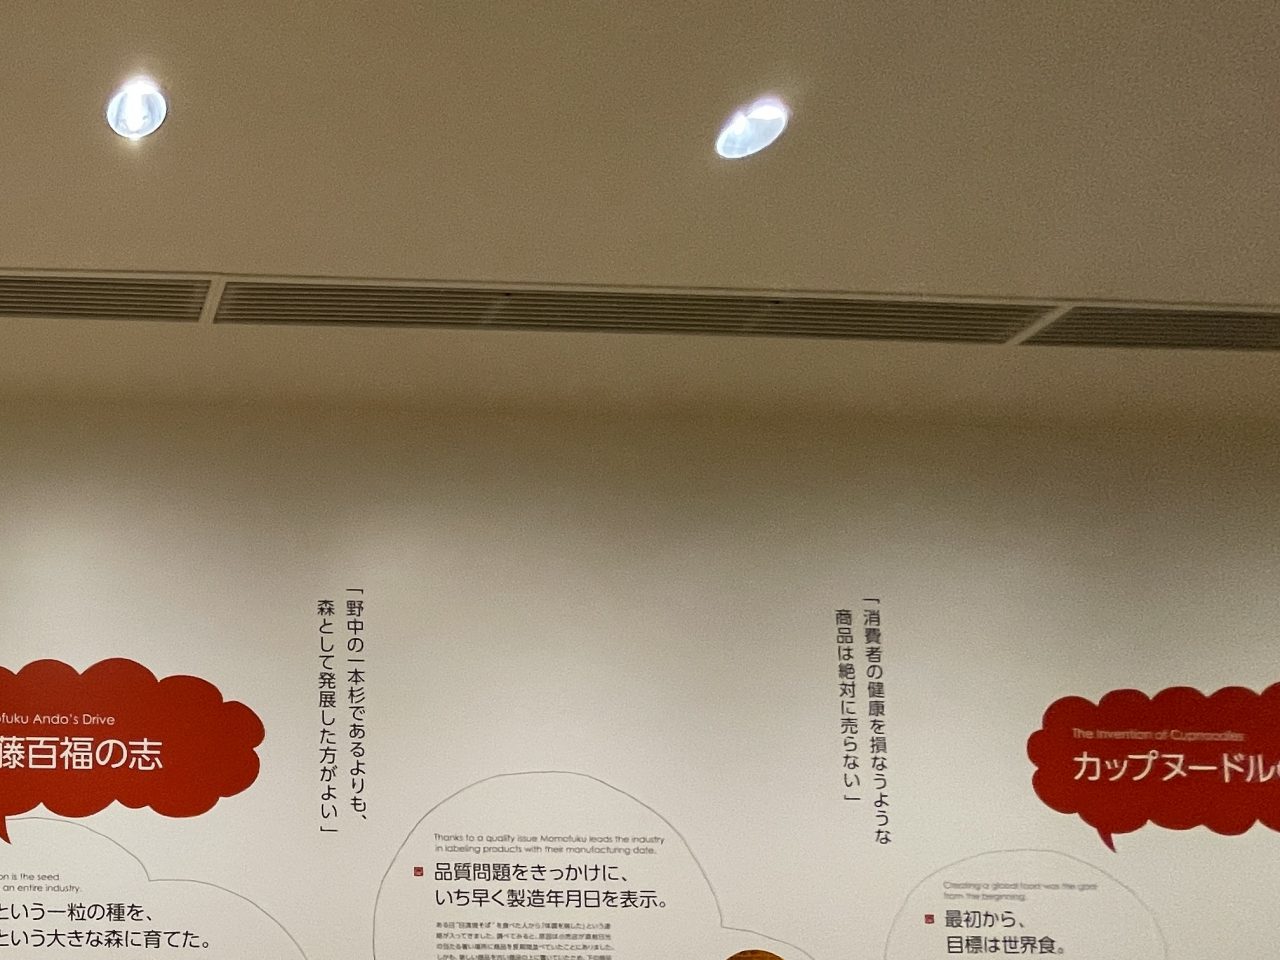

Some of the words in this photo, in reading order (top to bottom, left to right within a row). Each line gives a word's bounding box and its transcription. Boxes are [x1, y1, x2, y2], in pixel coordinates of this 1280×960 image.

[346, 588, 367, 820] 「野中の一本杉であるよりも、
[835, 609, 861, 801] 商品は絶対に売らない」
[82, 714, 115, 725] Drive
[317, 599, 338, 832] 森として発展した方がよい」
[863, 598, 892, 845] 「消費者の健康を損なうような
[1072, 728, 1094, 739] The
[1096, 730, 1154, 739] Invention
[1155, 730, 1169, 740] of
[1073, 750, 1280, 783] カップヌードル
[434, 833, 464, 842] Thanks
[465, 834, 474, 842] to
[485, 834, 514, 844] quality
[517, 834, 537, 843] issue
[540, 835, 587, 843] Momofuku
[589, 835, 613, 843] leads
[614, 835, 629, 843] the
[631, 836, 665, 845] industry
[445, 845, 481, 854] labeling
[483, 845, 522, 854] products
[566, 846, 631, 855] manufacturing
[435, 863, 627, 881] 品質問題をきっかけに、
[436, 889, 665, 908] いち早く製造年月日を表示。
[945, 910, 1024, 928] 最初から、
[947, 936, 1063, 954] 目標は世界食。
